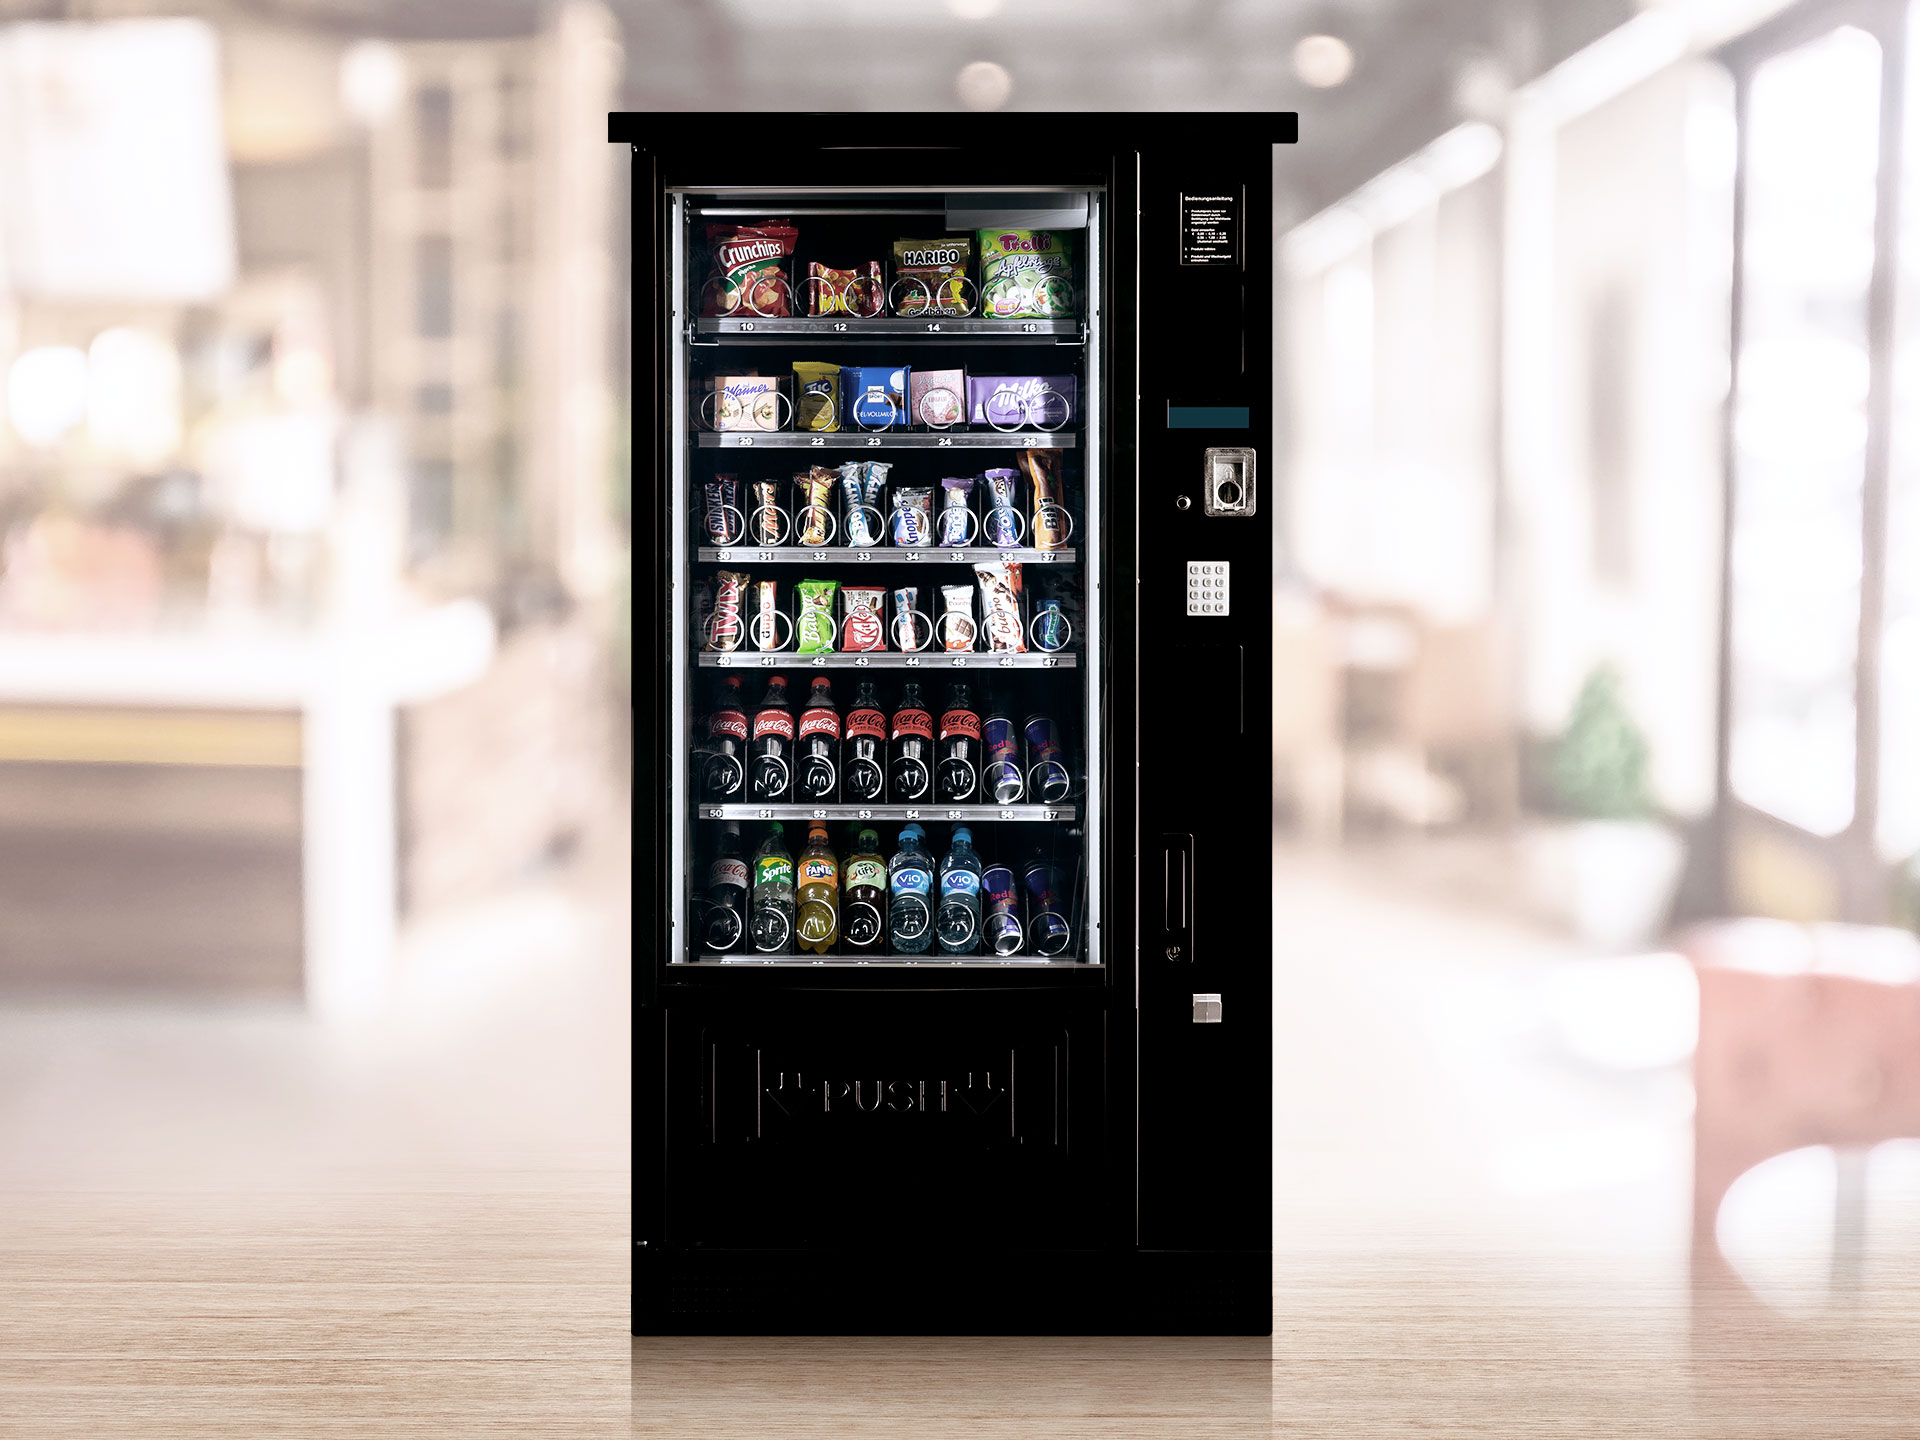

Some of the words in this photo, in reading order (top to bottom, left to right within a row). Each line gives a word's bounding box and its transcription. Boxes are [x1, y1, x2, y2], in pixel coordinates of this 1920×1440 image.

[998, 234, 1051, 251] Trolli
[719, 240, 781, 268] Crunchips
[904, 250, 959, 266] HARIBO
[995, 255, 1061, 277] Apfelringe
[927, 324, 940, 332] 14
[1023, 324, 1036, 332] 16
[992, 378, 1053, 408] Milka
[762, 483, 780, 538] Mars
[761, 602, 773, 638] dupo
[993, 598, 1010, 634] bueno
[710, 810, 722, 818] 50
[759, 810, 772, 818] 51
[813, 810, 827, 818] 52
[859, 810, 872, 818] 53
[906, 811, 919, 819] 54
[949, 811, 962, 819] 55
[1001, 811, 1014, 819] 56
[1045, 811, 1058, 819] 57
[712, 864, 749, 880] Coca-Col
[762, 862, 791, 883] Sprite
[806, 864, 833, 876] FANTA
[824, 1080, 946, 1112] PUSH
